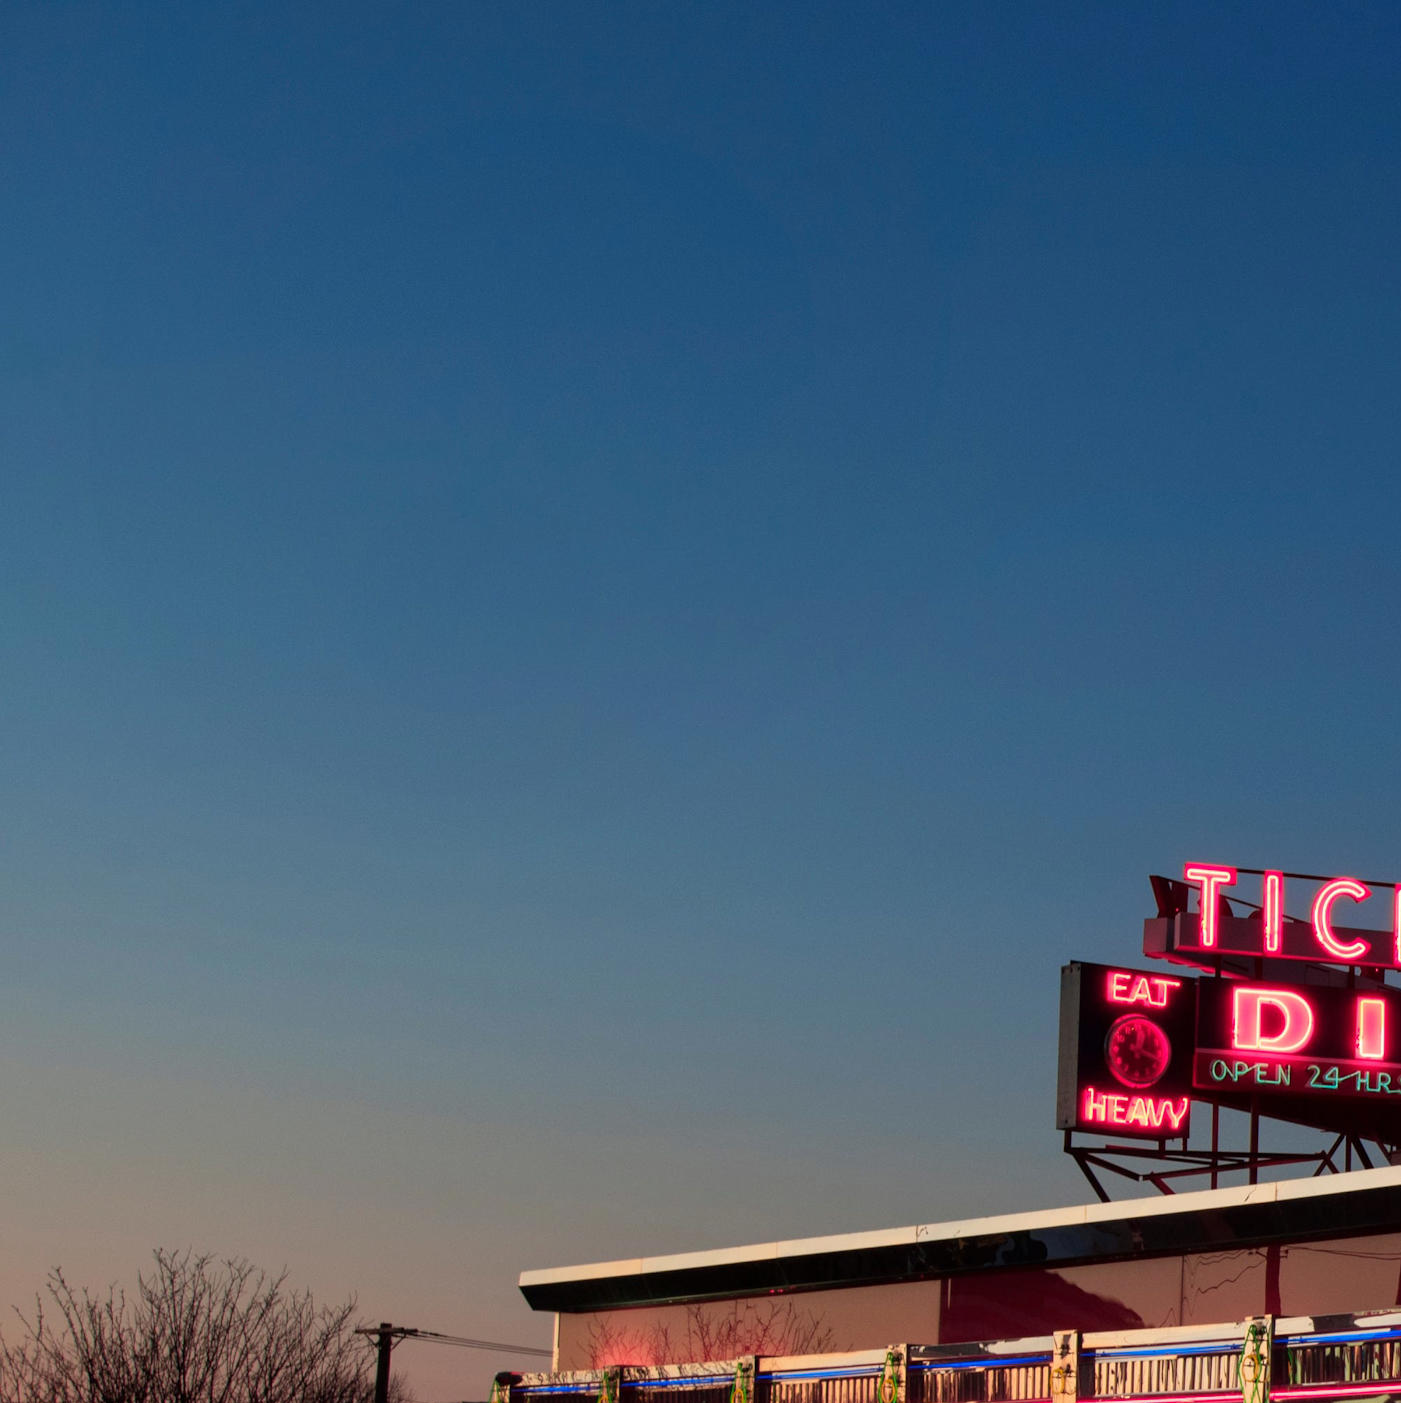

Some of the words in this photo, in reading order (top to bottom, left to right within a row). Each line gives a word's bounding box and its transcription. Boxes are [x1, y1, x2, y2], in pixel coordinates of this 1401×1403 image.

[1106, 971, 1181, 1007] EAT
[1211, 1059, 1291, 1086] OPEN
[1306, 1064, 1339, 1090] 24
[1082, 1086, 1189, 1131] HEAVY
